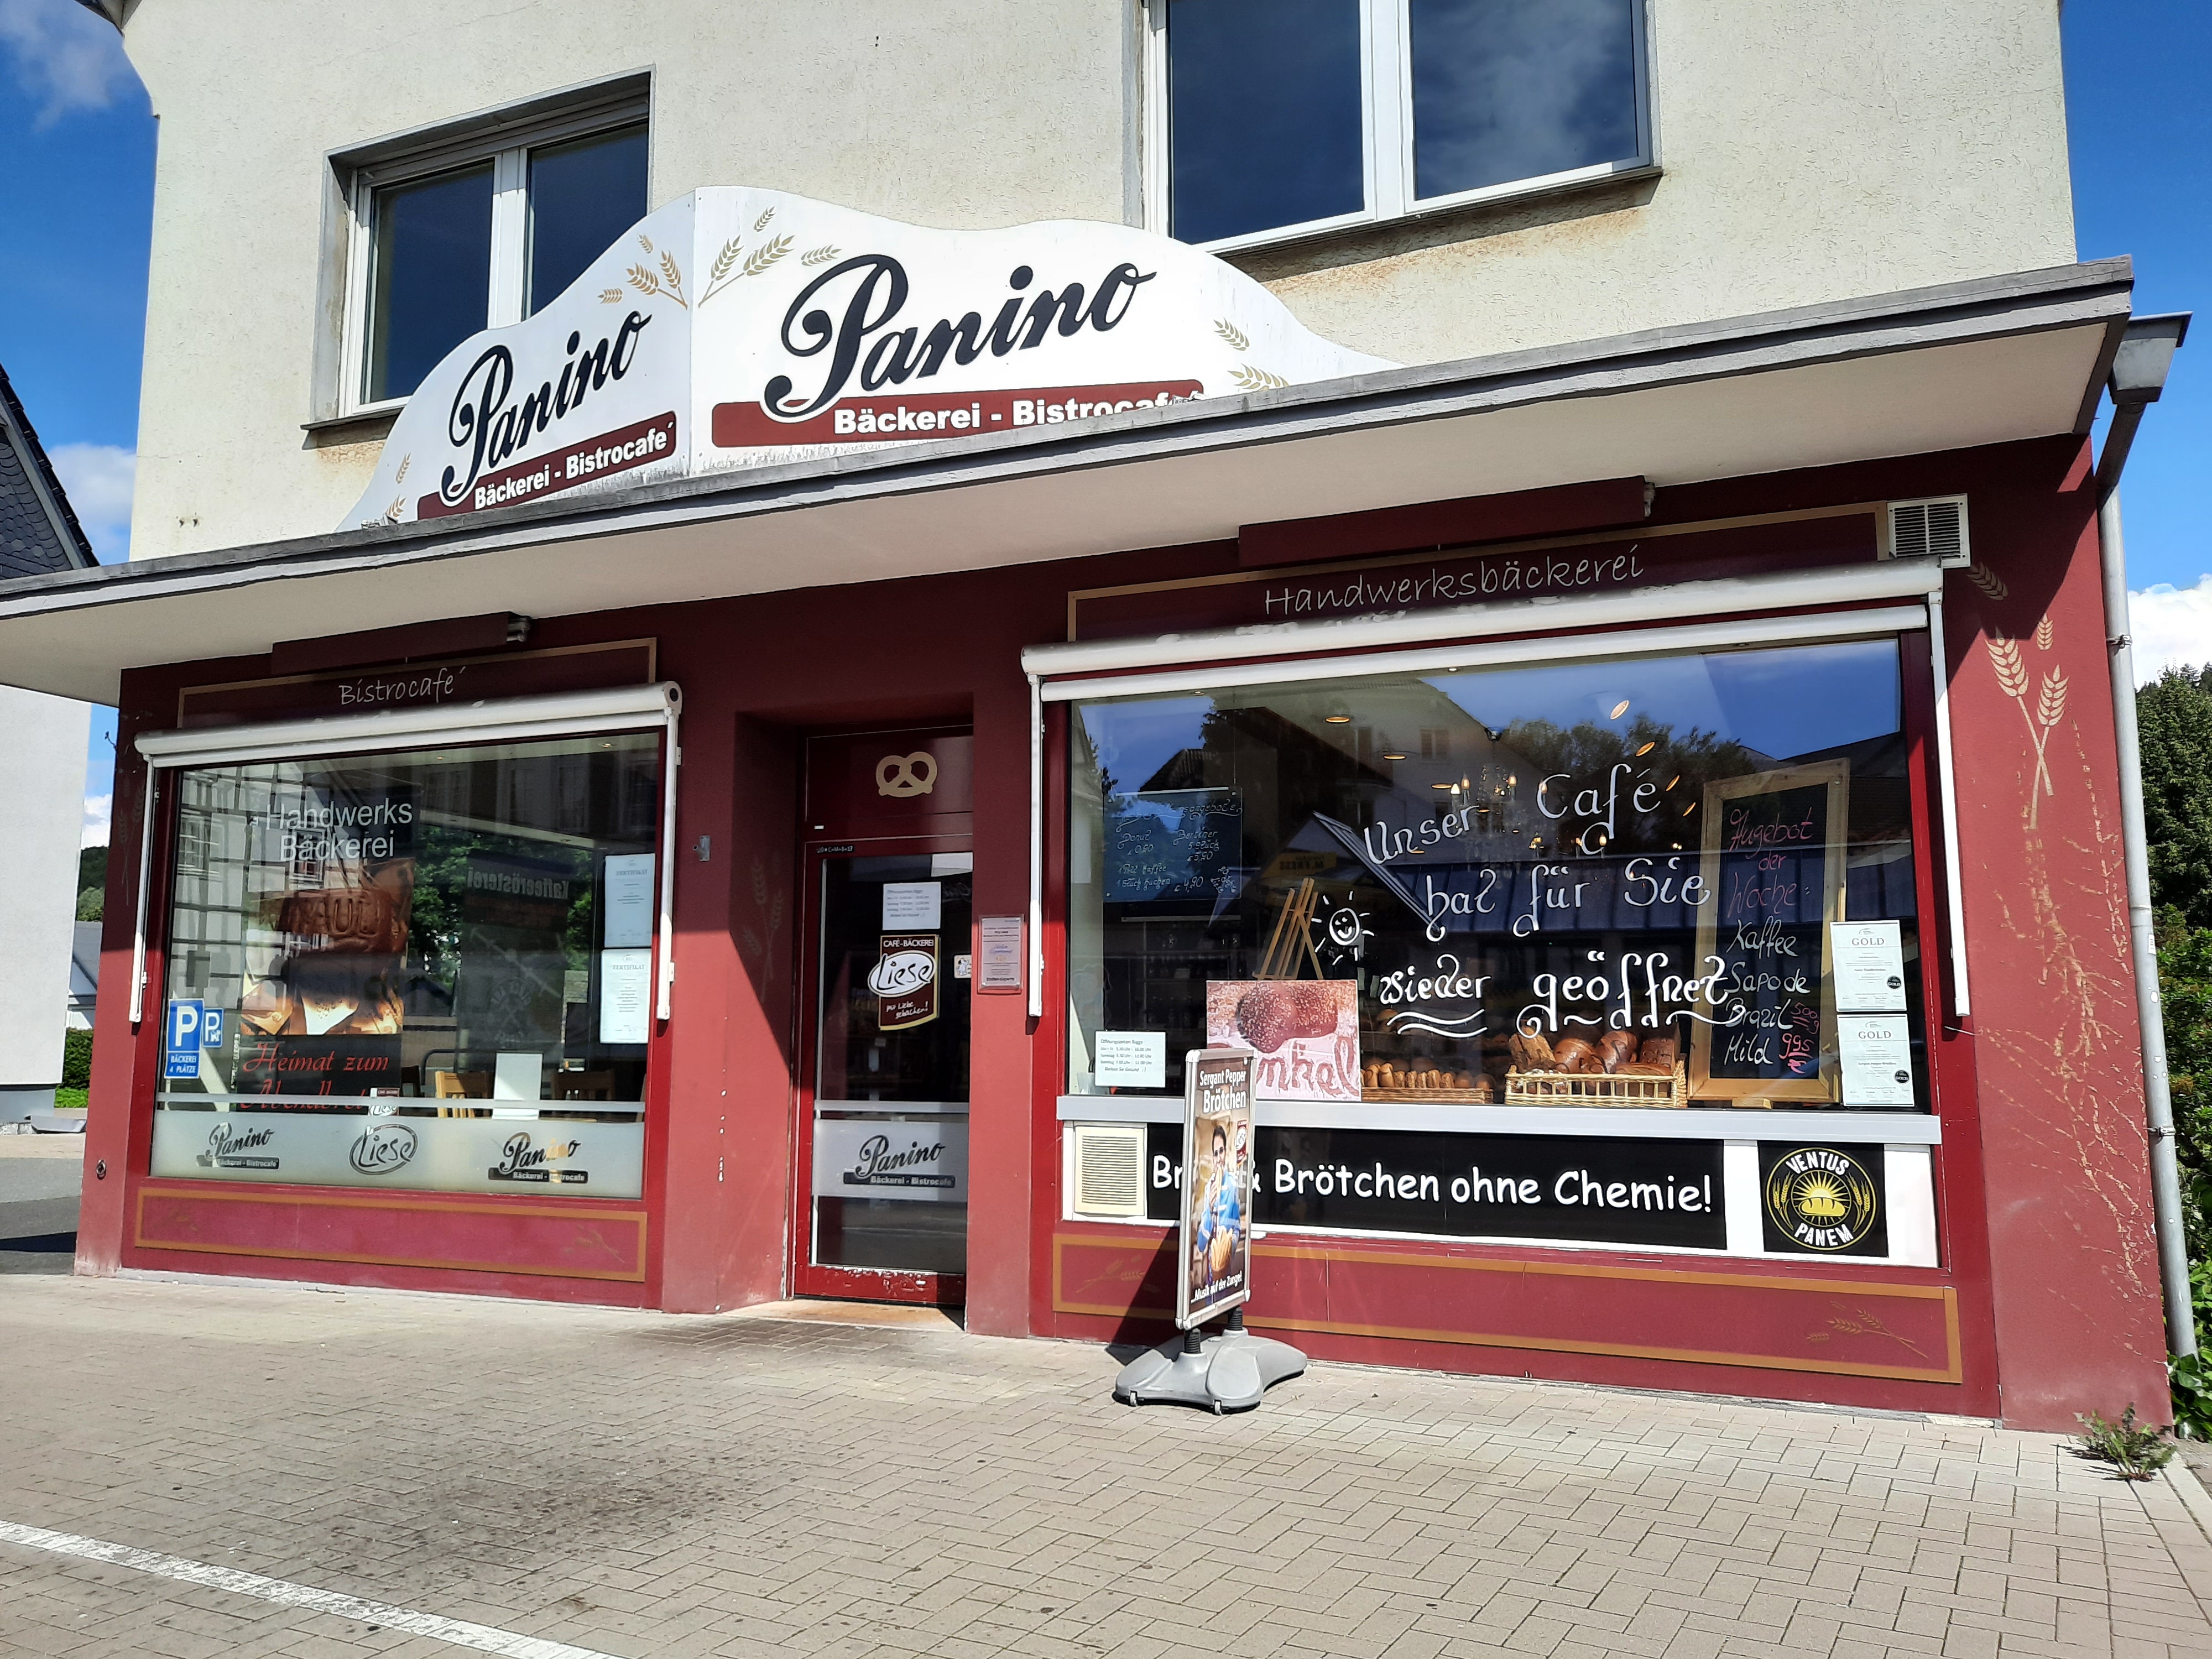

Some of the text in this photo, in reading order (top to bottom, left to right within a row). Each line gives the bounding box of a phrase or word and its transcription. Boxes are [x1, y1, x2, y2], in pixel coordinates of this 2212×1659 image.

[765, 254, 1157, 418] Panino
[442, 311, 652, 501] Panino
[834, 402, 981, 435] Bäckerei
[474, 465, 550, 509] Bäckerei
[1265, 544, 1645, 615] Handwerksbäckerei
[266, 797, 413, 830] Handwerks
[1364, 763, 1661, 864] Unser Café
[280, 830, 394, 861] Bäckerei
[1758, 852, 1786, 871] der
[1426, 857, 1712, 942] hat für Sie
[1726, 915, 1798, 959] Kaffee
[1851, 937, 1885, 946] GOLD
[877, 954, 931, 990] Liese
[1516, 950, 1729, 1039] geöffnet
[175, 1005, 198, 1047] P
[205, 1013, 221, 1042] P
[1858, 1031, 1891, 1040] GOLD
[170, 1054, 197, 1063] BÄCKEREI
[242, 1042, 389, 1072] Heimat zum
[1724, 1032, 1774, 1066] Mild
[176, 1063, 197, 1073] PLÄTZE
[1199, 1068, 1246, 1089] Sergant Pepper
[1203, 1086, 1246, 1113] Brötchen
[205, 1122, 275, 1159] Panino
[358, 1125, 412, 1167] Liese
[854, 1134, 947, 1178] Panino
[1785, 1151, 1850, 1175] VENTUS
[871, 1176, 905, 1184] Bäckerei
[1274, 1159, 1439, 1202] Brötchen
[1451, 1166, 1542, 1205] ohne
[1554, 1169, 1712, 1213] Chemie!
[1793, 1222, 1854, 1246] PANEM
